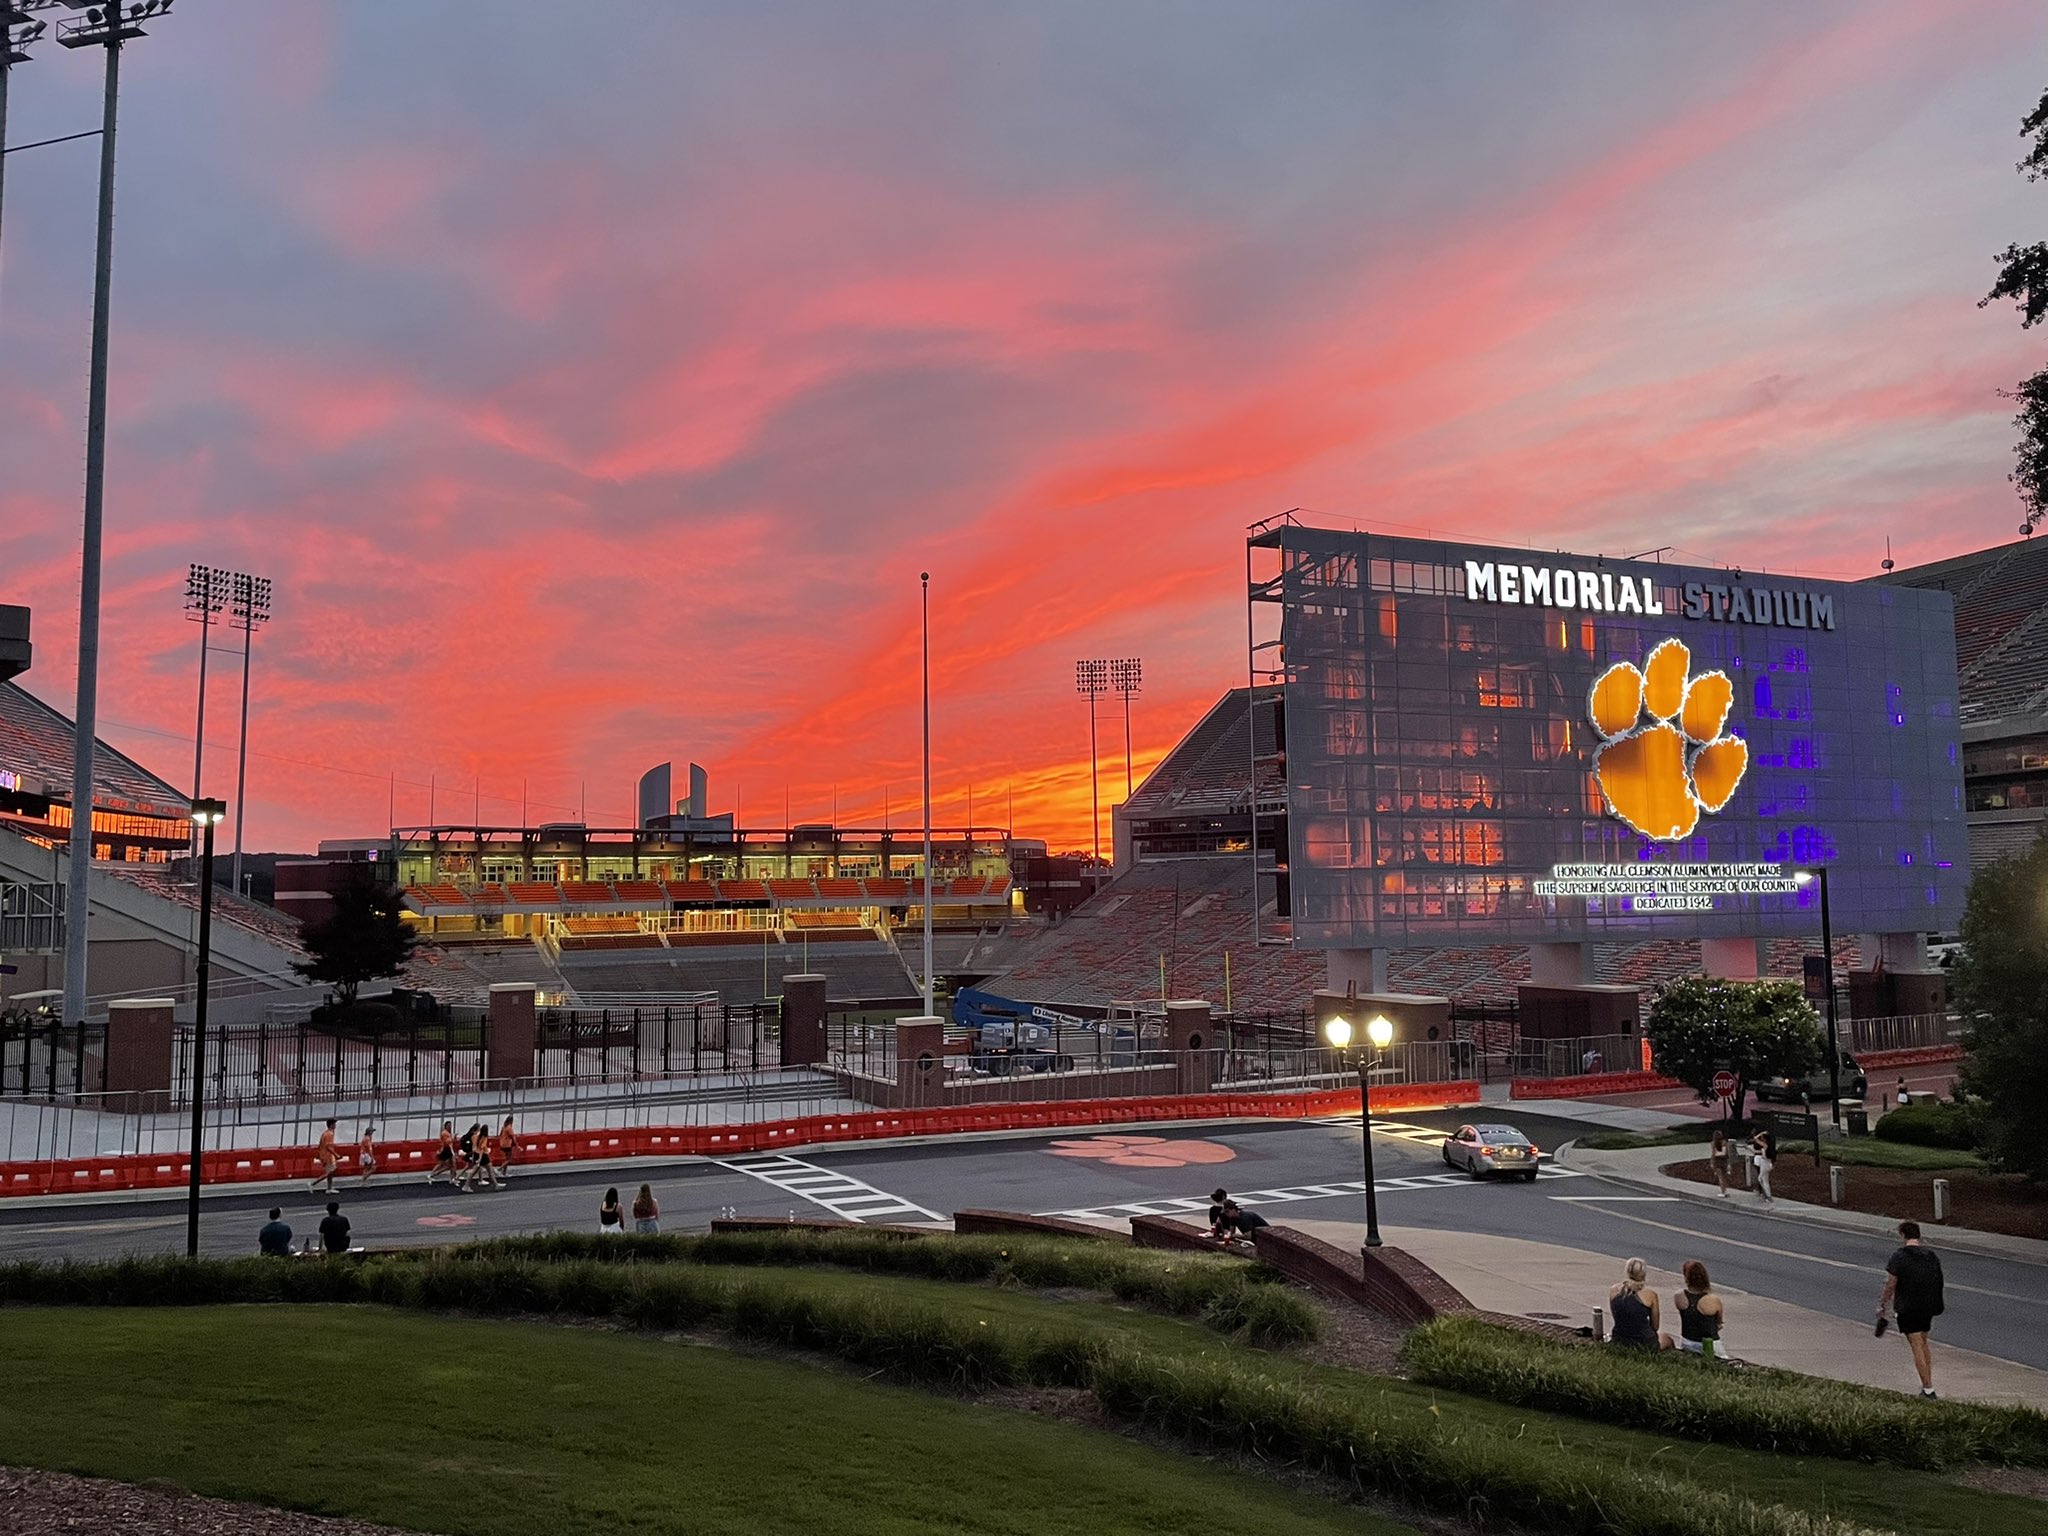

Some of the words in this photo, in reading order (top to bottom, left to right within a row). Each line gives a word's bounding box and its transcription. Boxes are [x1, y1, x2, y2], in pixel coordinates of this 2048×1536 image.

[1465, 560, 1663, 616] MEMORIAL
[1682, 582, 1835, 630] STADIUM
[1556, 865, 1607, 877] HONORING
[1609, 865, 1625, 877] ALL
[1627, 864, 1672, 877] CLEMSON
[1674, 864, 1708, 877] ALUMNI
[1757, 864, 1781, 876] MADE
[1536, 882, 1556, 894] THE
[1558, 882, 1605, 893] SUPREME
[1607, 881, 1655, 893] SACRIFICE
[1656, 881, 1667, 893] IN
[1670, 881, 1687, 892] THE
[1688, 881, 1726, 892] SERVICE
[1727, 880, 1738, 891] OF
[1740, 880, 1760, 892] OUR
[1636, 897, 1687, 909] DEDICATED
[1715, 1079, 1734, 1089] STOP
